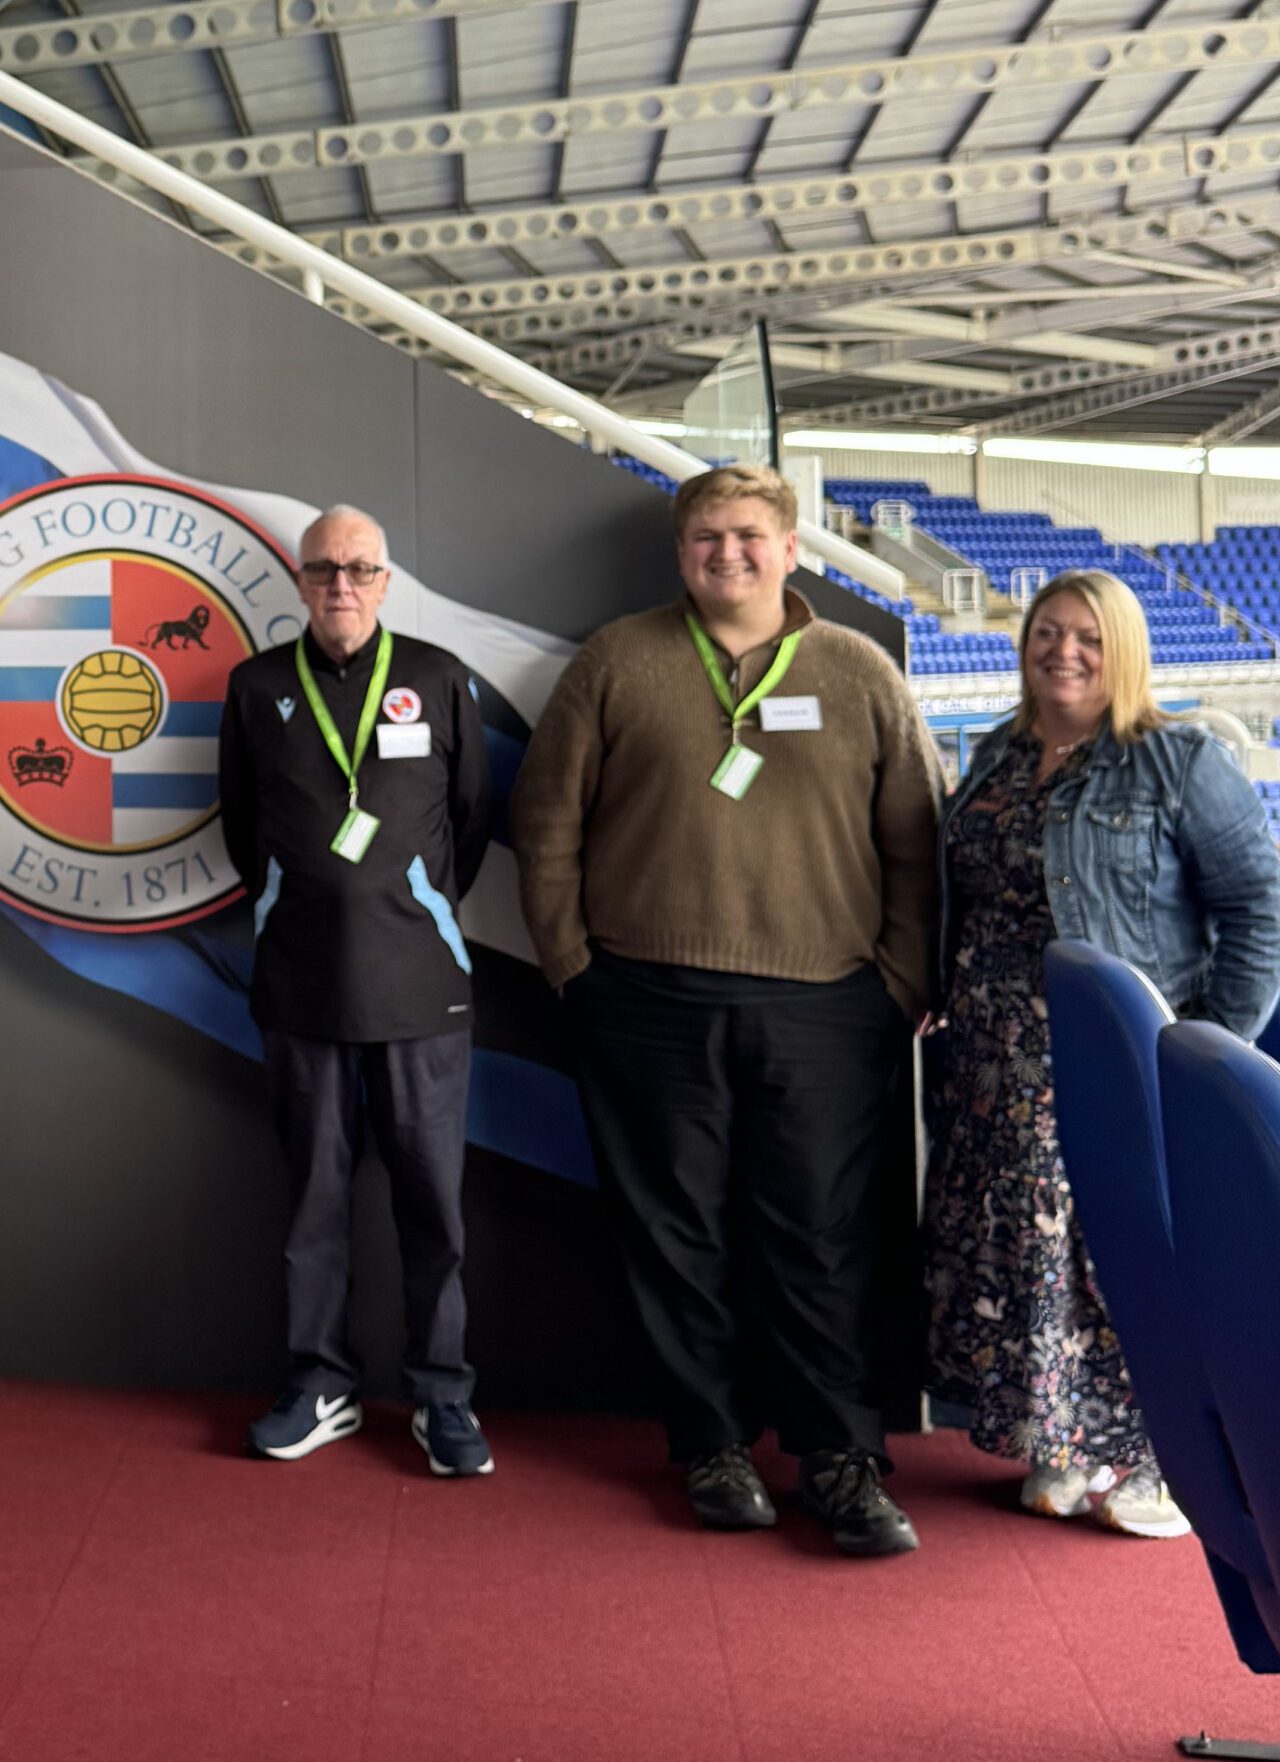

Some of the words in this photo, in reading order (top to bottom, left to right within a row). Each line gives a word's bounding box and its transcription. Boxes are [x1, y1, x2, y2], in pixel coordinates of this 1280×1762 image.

[32, 498, 271, 608] FOOTBALL
[8, 844, 100, 907] EST.
[121, 852, 216, 907] 1871
